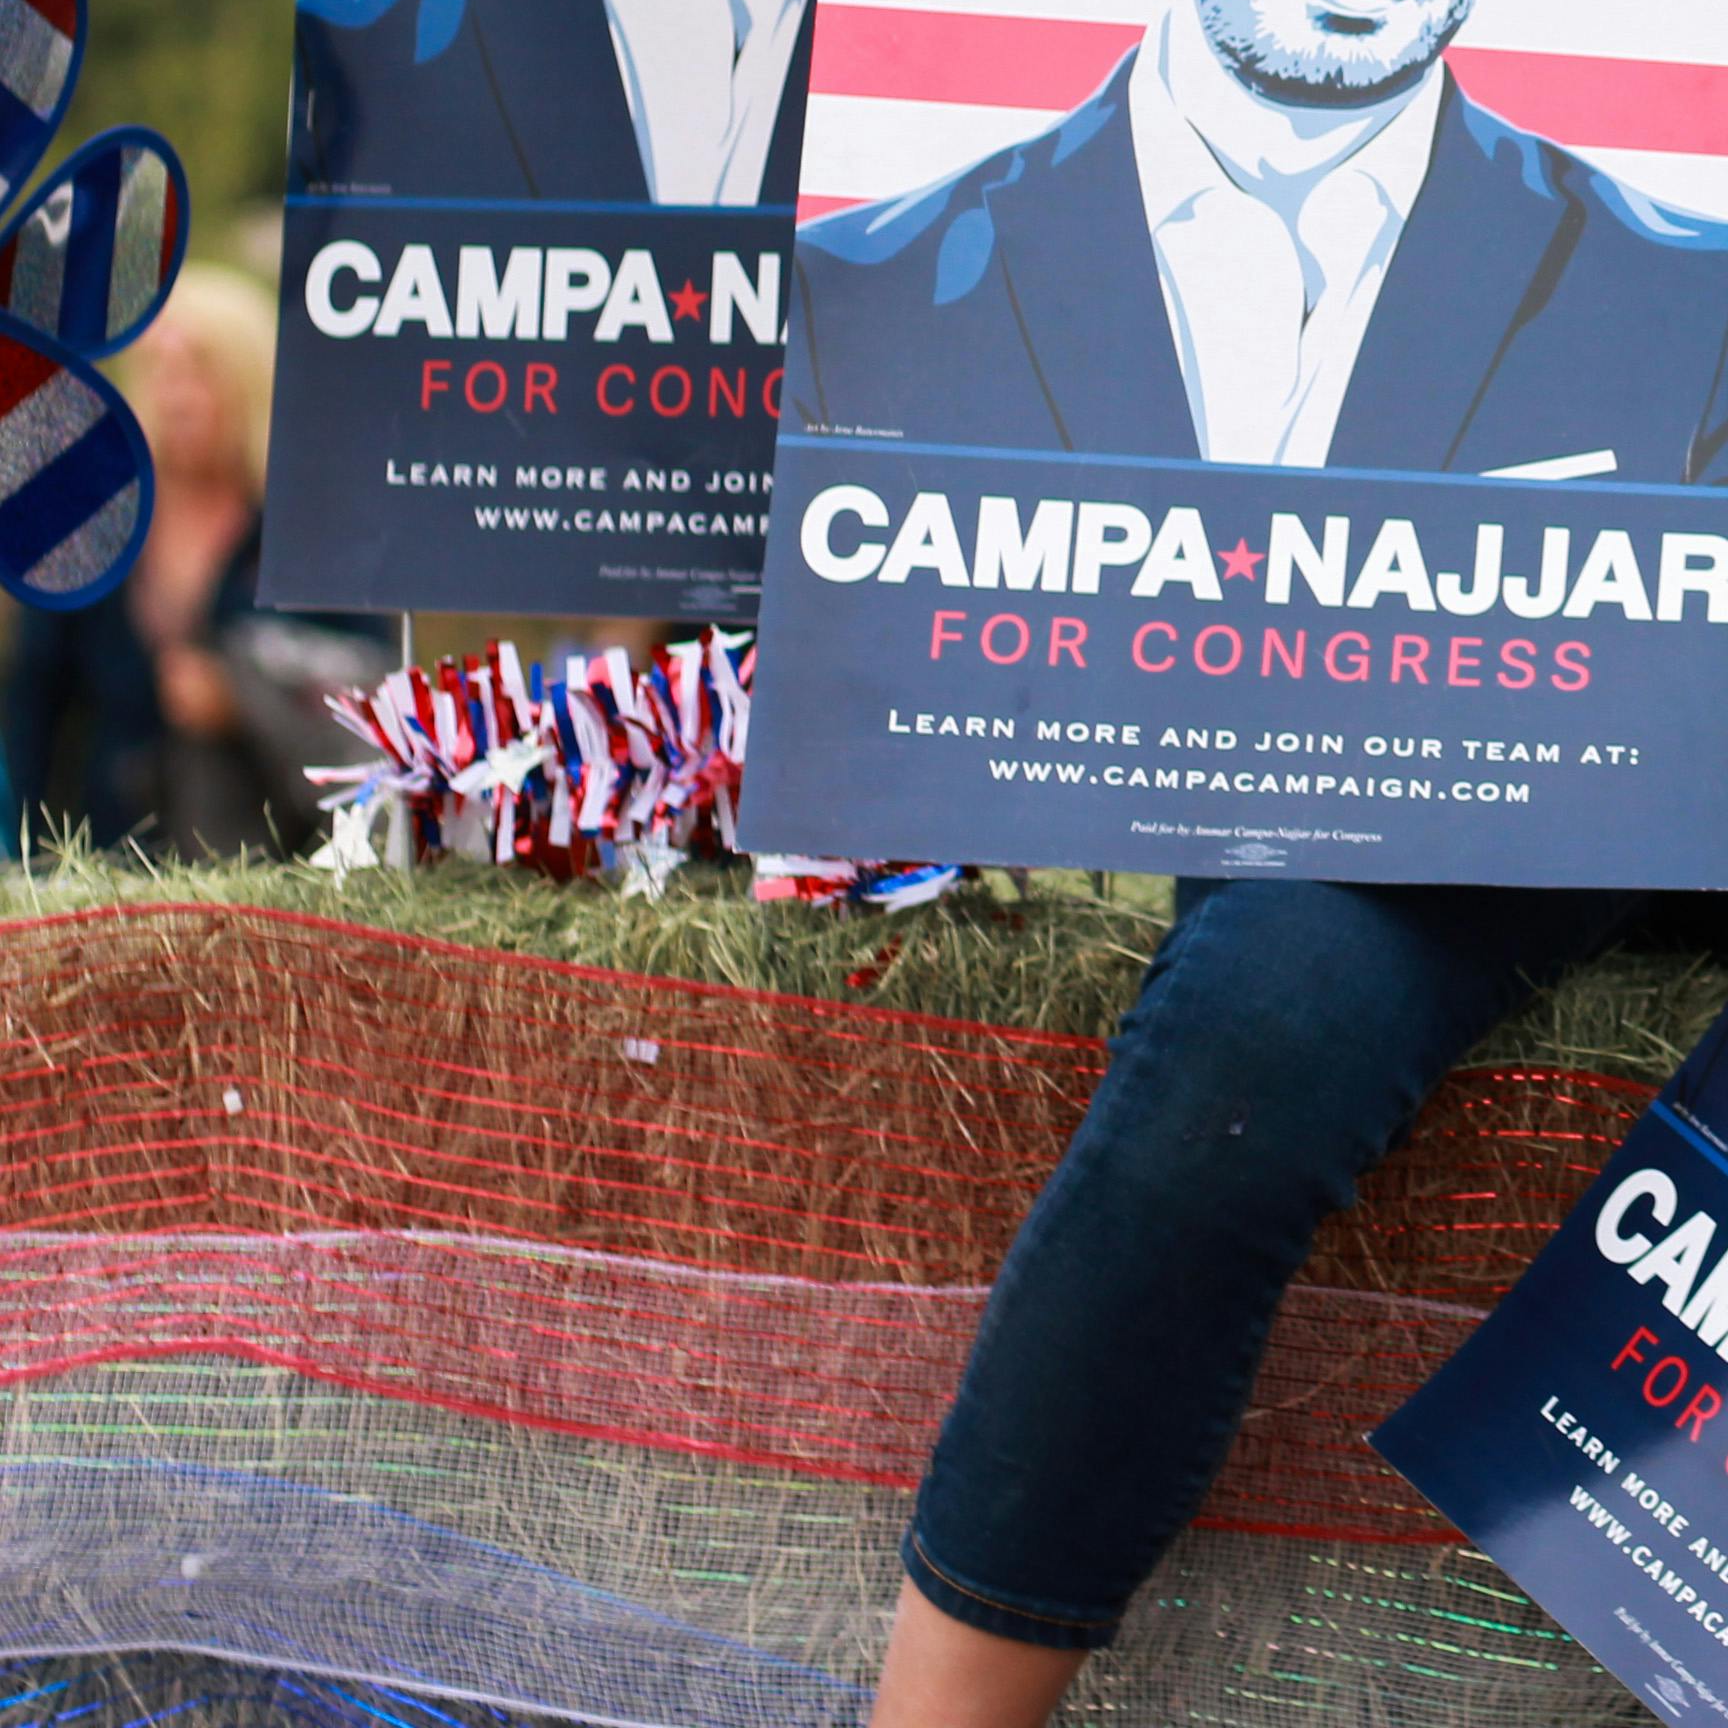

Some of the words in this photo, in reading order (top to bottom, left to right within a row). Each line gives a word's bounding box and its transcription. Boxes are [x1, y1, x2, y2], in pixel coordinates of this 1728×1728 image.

[306, 241, 673, 342] CAMPA
[422, 360, 558, 413] FOR
[387, 460, 496, 486] LEARN
[516, 467, 604, 489] MORE
[624, 470, 690, 491] AND
[707, 472, 772, 492] JOIN
[801, 485, 1222, 600] CAMPA
[930, 610, 1088, 668] FOR
[1132, 621, 1592, 691] CONGRESS
[889, 710, 1014, 738] LEARN
[1038, 721, 1140, 745] MORE
[1160, 728, 1236, 749] AND
[1255, 733, 1343, 753] JOIN
[1364, 737, 1442, 758] OUR
[1463, 741, 1559, 762] TEAM
[1581, 746, 1638, 764] AT:
[989, 759, 1531, 803] WWW.CAMPACAMPAIGN.COM
[1612, 1327, 1722, 1440] FOR
[1541, 1396, 1620, 1474] LEARN
[1622, 1473, 1688, 1537] MORE
